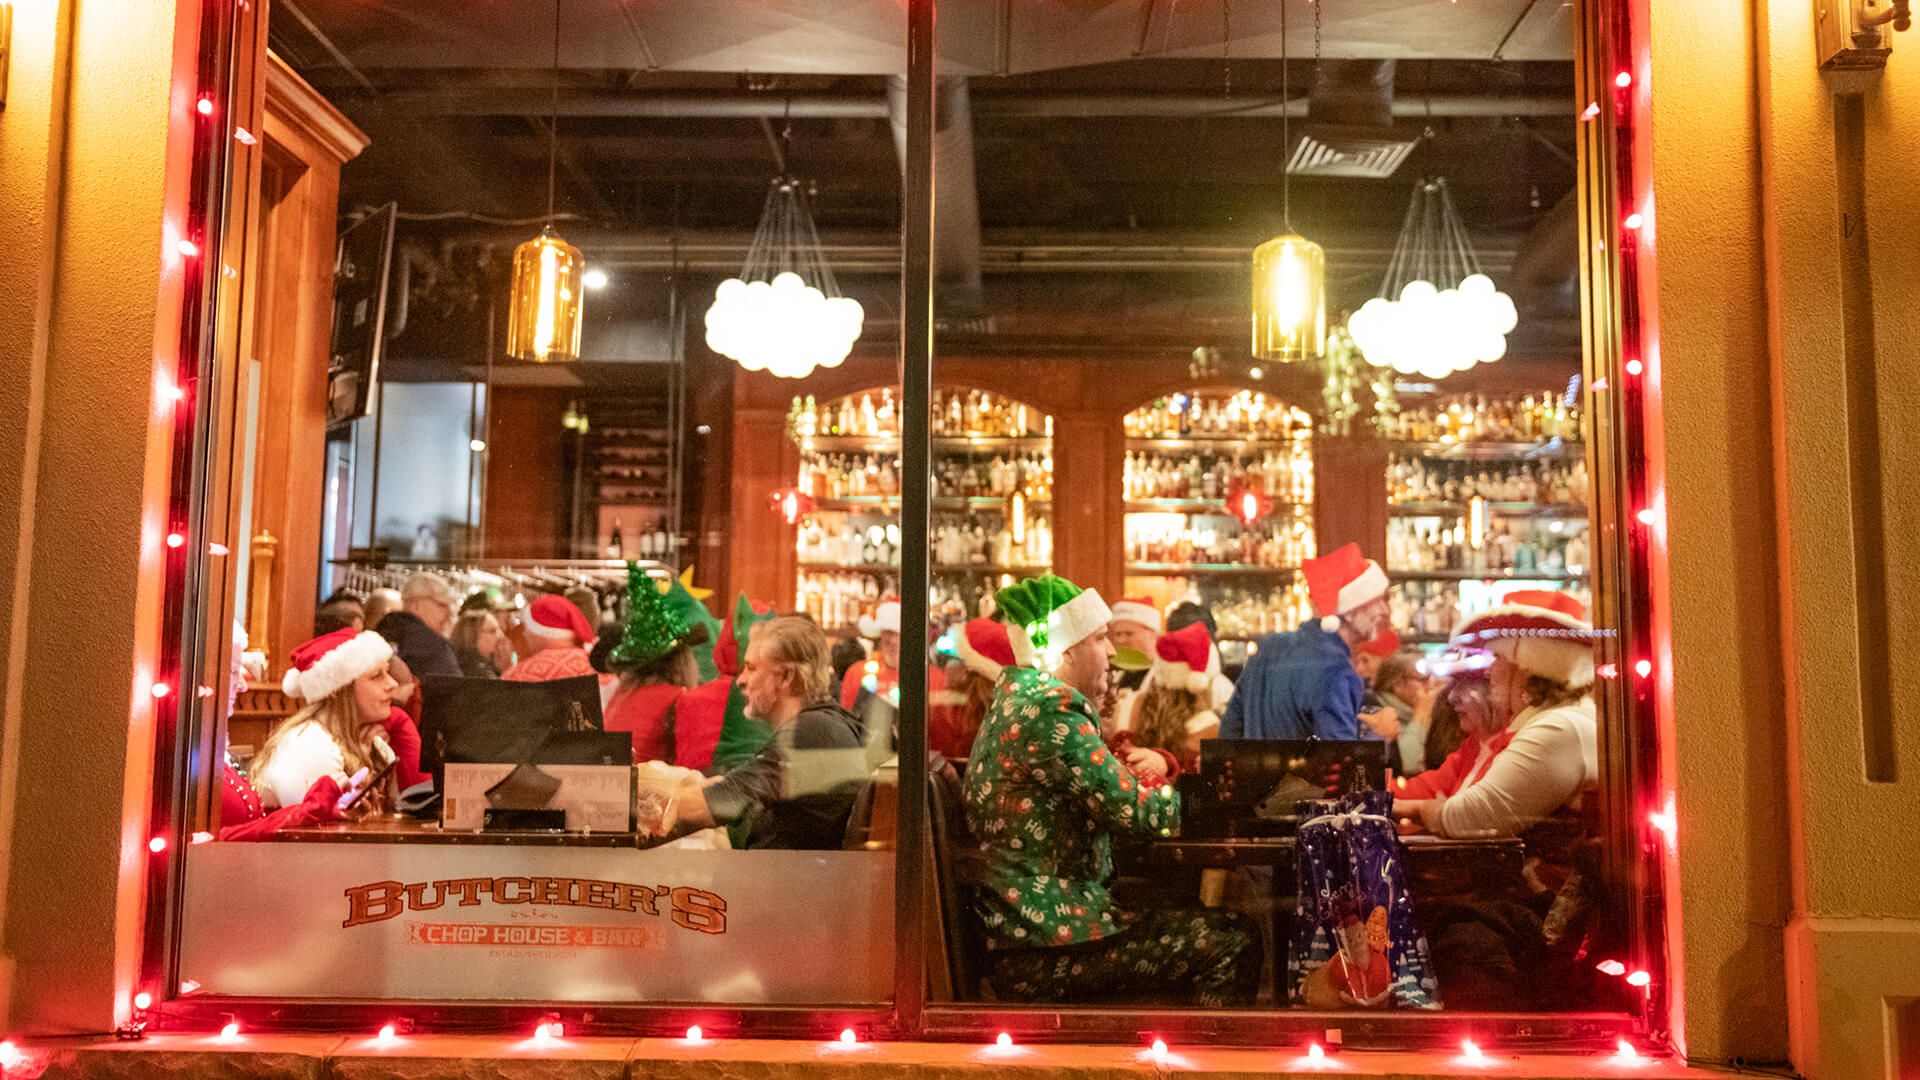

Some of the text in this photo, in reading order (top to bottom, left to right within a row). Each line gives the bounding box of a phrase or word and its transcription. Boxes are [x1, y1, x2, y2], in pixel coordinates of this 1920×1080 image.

[1051, 723, 1070, 745] HO
[342, 876, 727, 935] BUTCHER'S
[1021, 905, 1045, 924] HO
[427, 925, 488, 944] CHOP
[493, 926, 569, 945] HOUSE
[591, 928, 641, 945] BAR
